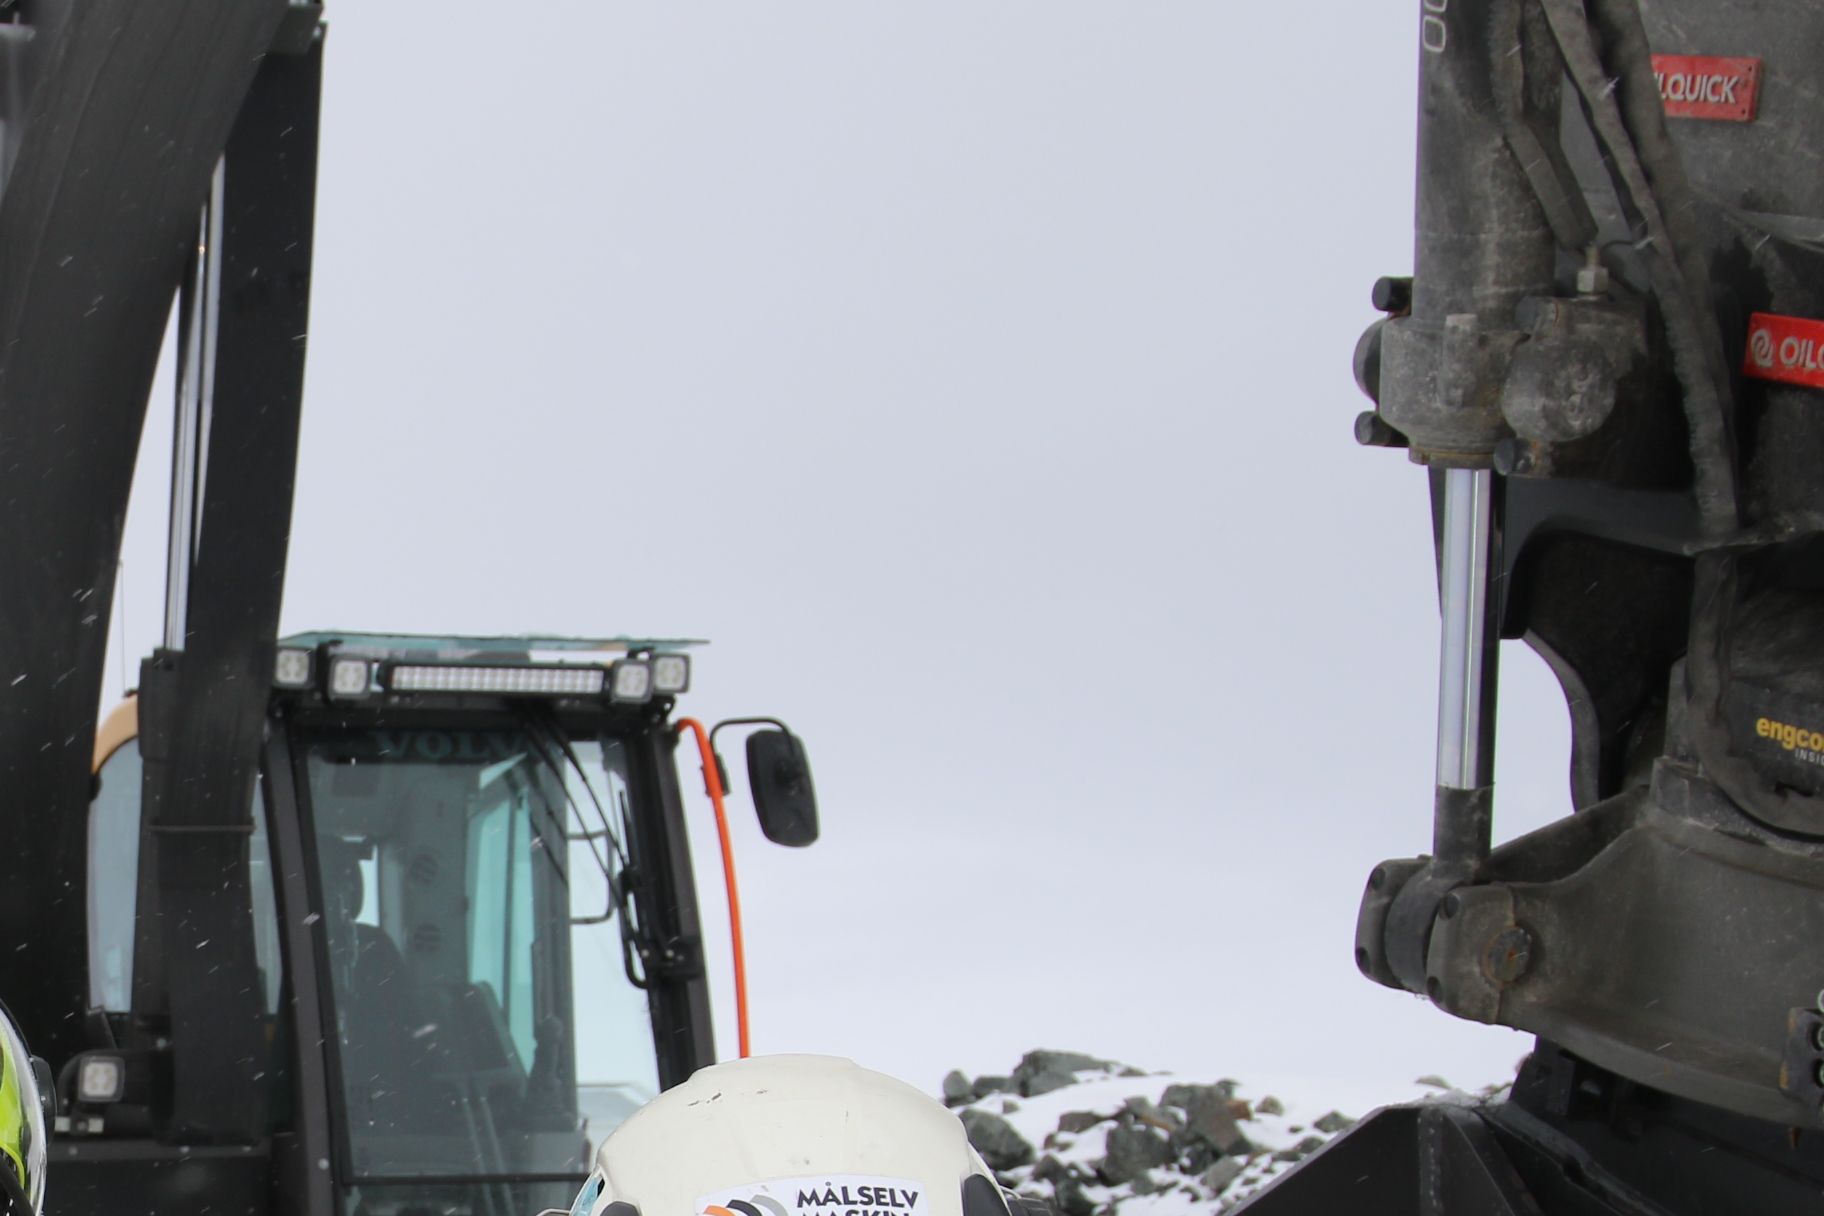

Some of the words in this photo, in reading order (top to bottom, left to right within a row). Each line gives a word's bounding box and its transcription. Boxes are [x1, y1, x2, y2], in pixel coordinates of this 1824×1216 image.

[1654, 71, 1739, 104] LQUICK
[1756, 717, 1824, 752] engco
[797, 1181, 919, 1209] MÅLSELV
